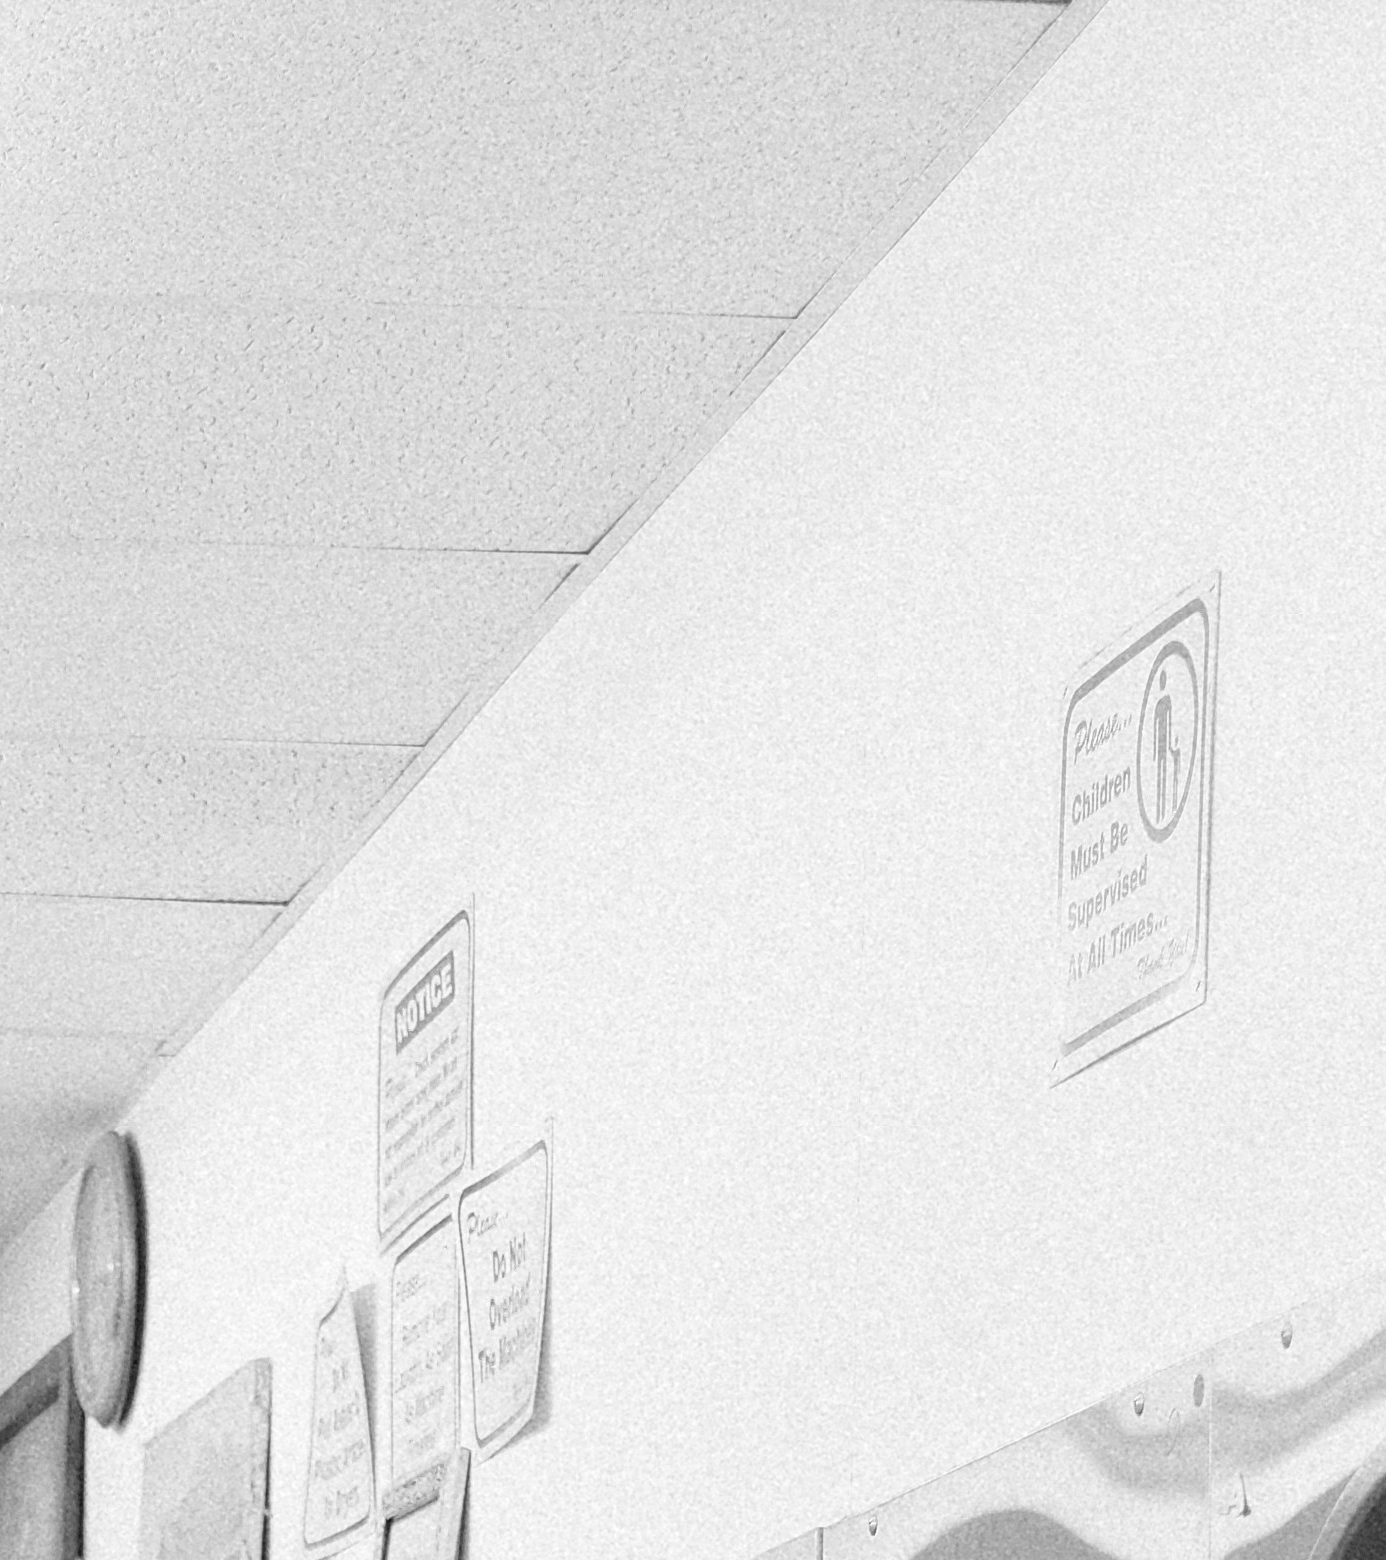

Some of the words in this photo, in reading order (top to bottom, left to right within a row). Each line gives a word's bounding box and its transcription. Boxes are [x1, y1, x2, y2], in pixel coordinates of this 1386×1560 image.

[1072, 766, 1132, 826] Children
[1070, 831, 1105, 880] Must
[1109, 821, 1130, 855] Be
[1067, 853, 1149, 931] Supervised
[1068, 951, 1084, 987] At
[1087, 935, 1107, 974] All
[1110, 911, 1169, 959] Times...
[396, 961, 454, 1045] NOTICE
[491, 1248, 507, 1284] Do
[509, 1231, 528, 1272] Not
[489, 1271, 532, 1331] Overload
[477, 1347, 497, 1383] The
